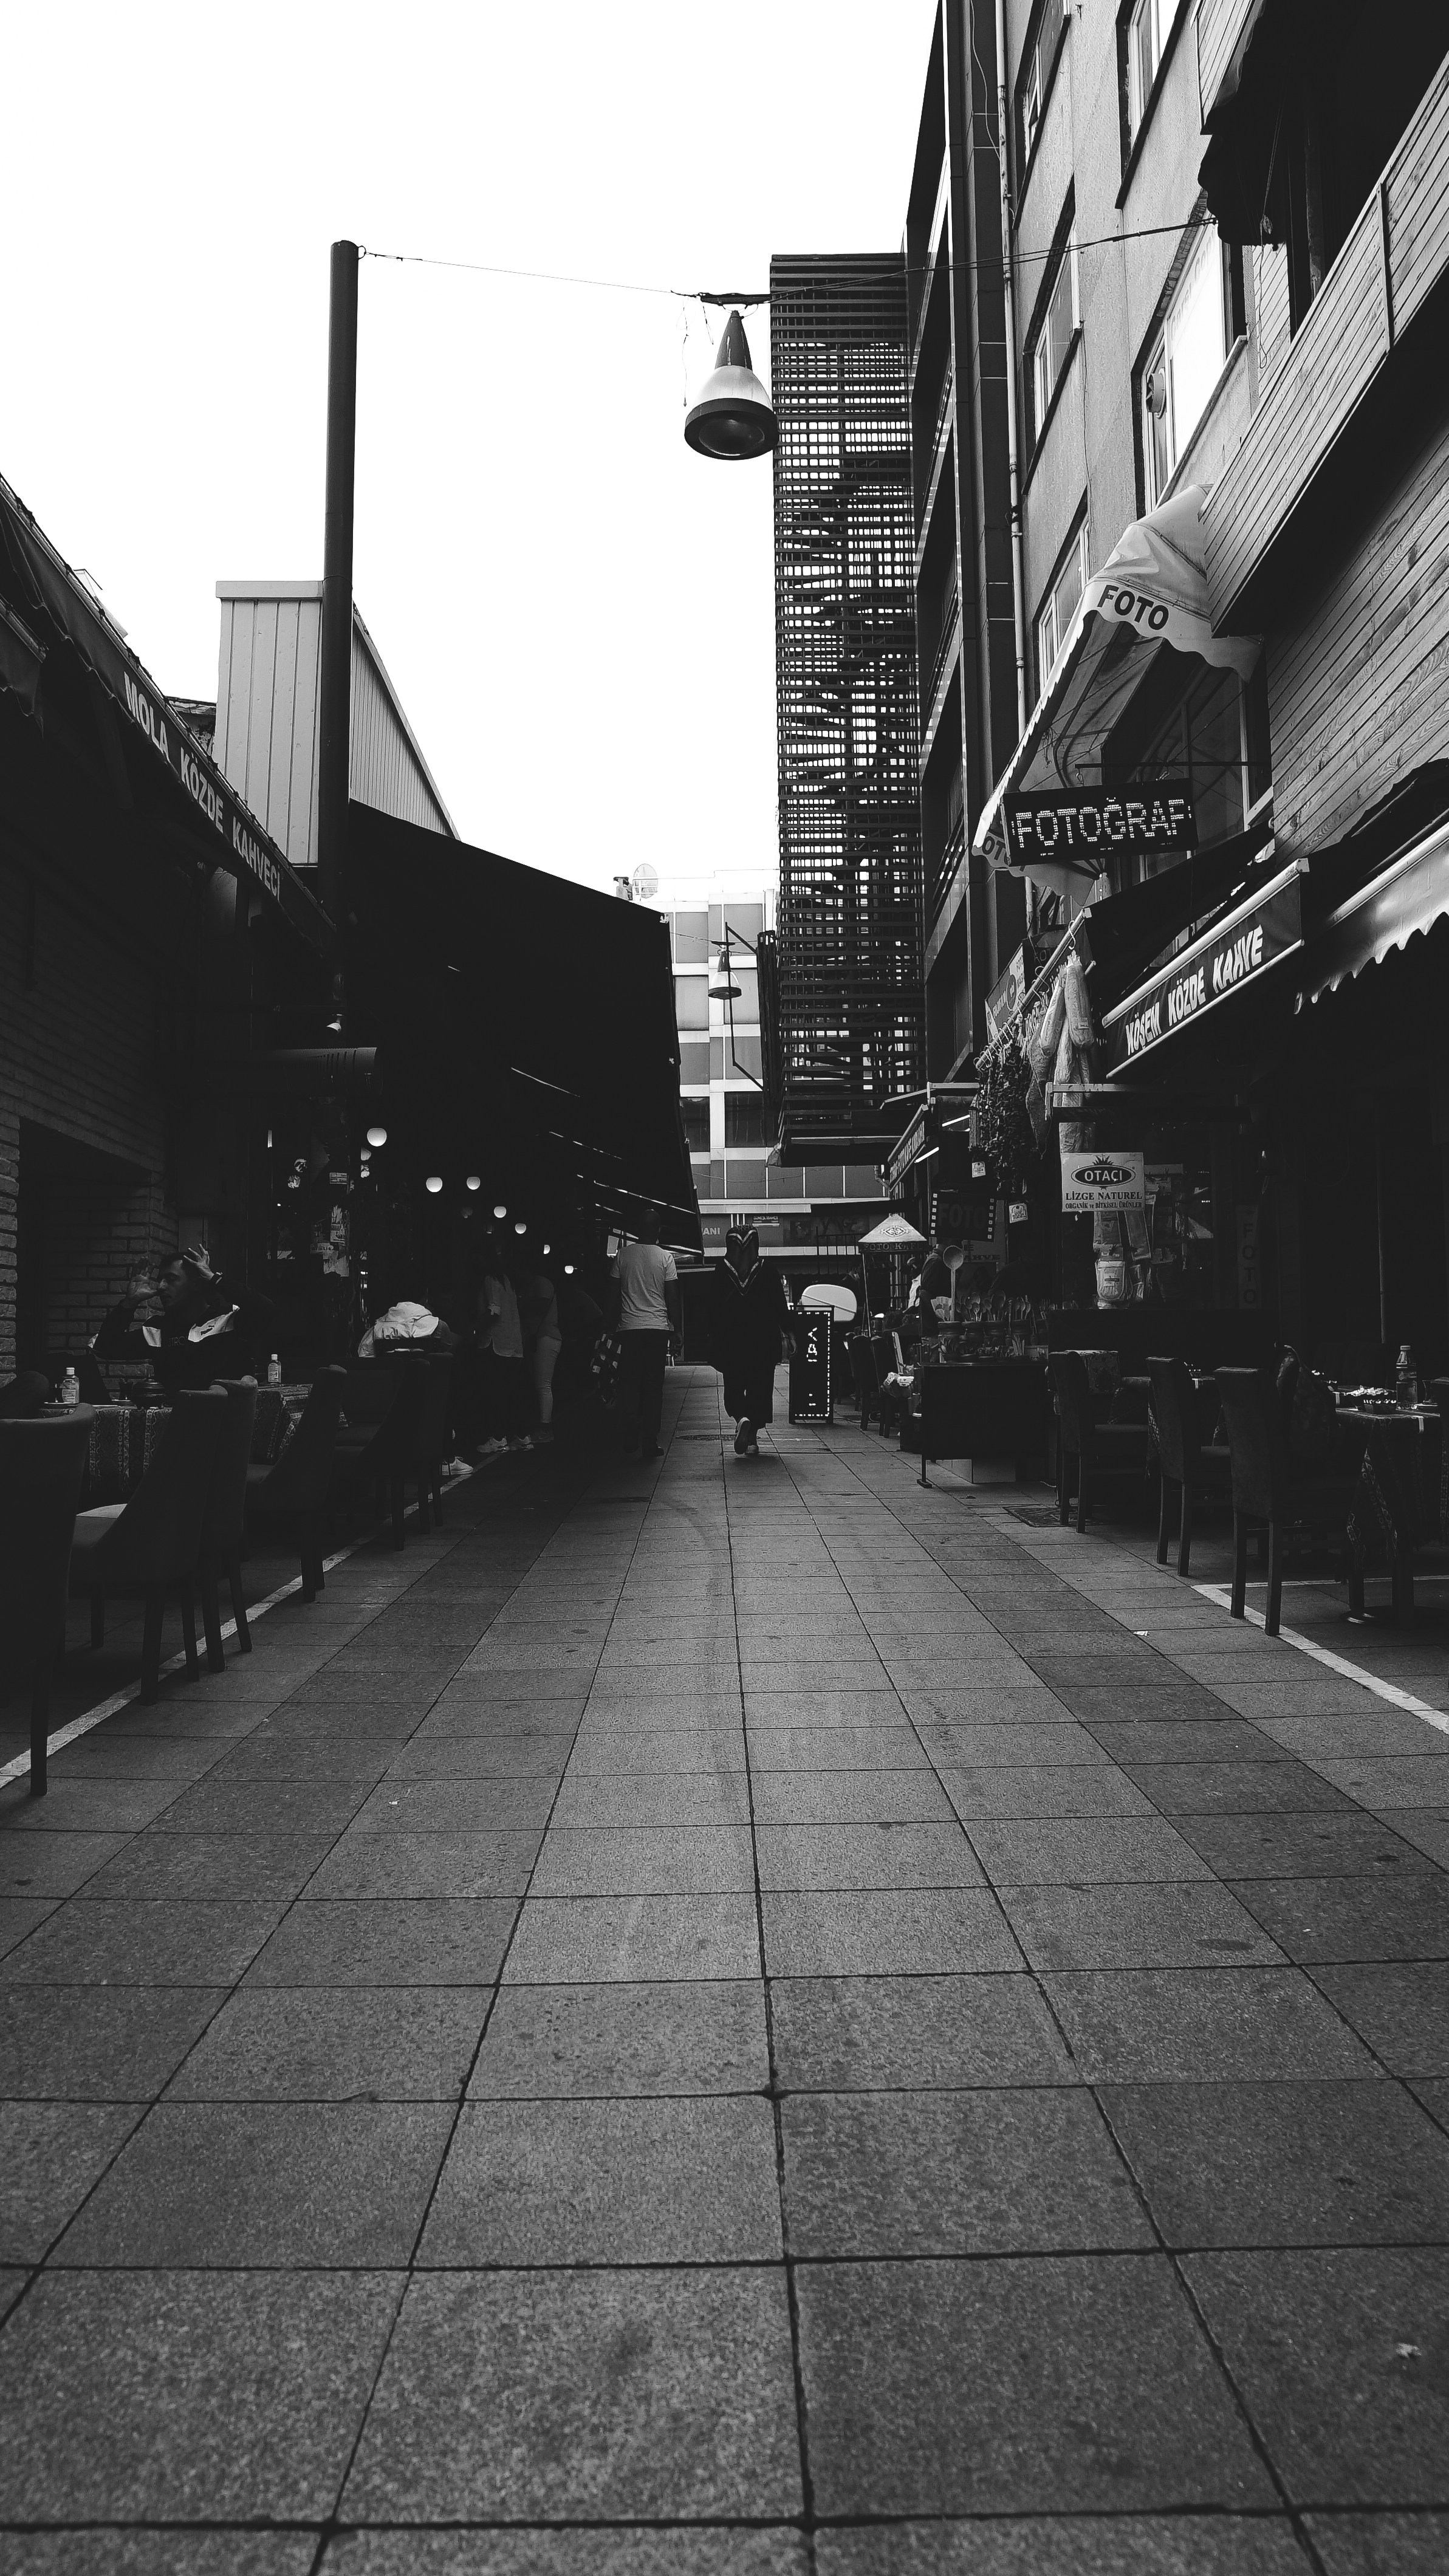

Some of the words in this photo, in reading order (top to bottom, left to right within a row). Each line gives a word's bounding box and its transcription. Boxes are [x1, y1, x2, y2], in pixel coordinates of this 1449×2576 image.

[1097, 584, 1169, 631] FOTO
[123, 671, 170, 764] MOLA
[180, 747, 225, 834] KÖZDE
[232, 815, 280, 900] KAHVECİ
[1015, 796, 1185, 849] FOTOĞRAF
[1126, 1001, 1162, 1056] KÖŞEM
[1168, 966, 1207, 1027] KÖZDE
[1213, 924, 1263, 993] KAHVE
[1065, 1191, 1094, 1201] LİZGE
[1098, 1191, 1143, 1201] NATUREL
[1084, 1170, 1122, 1183] OTAÇI
[938, 1203, 987, 1230] FOTO
